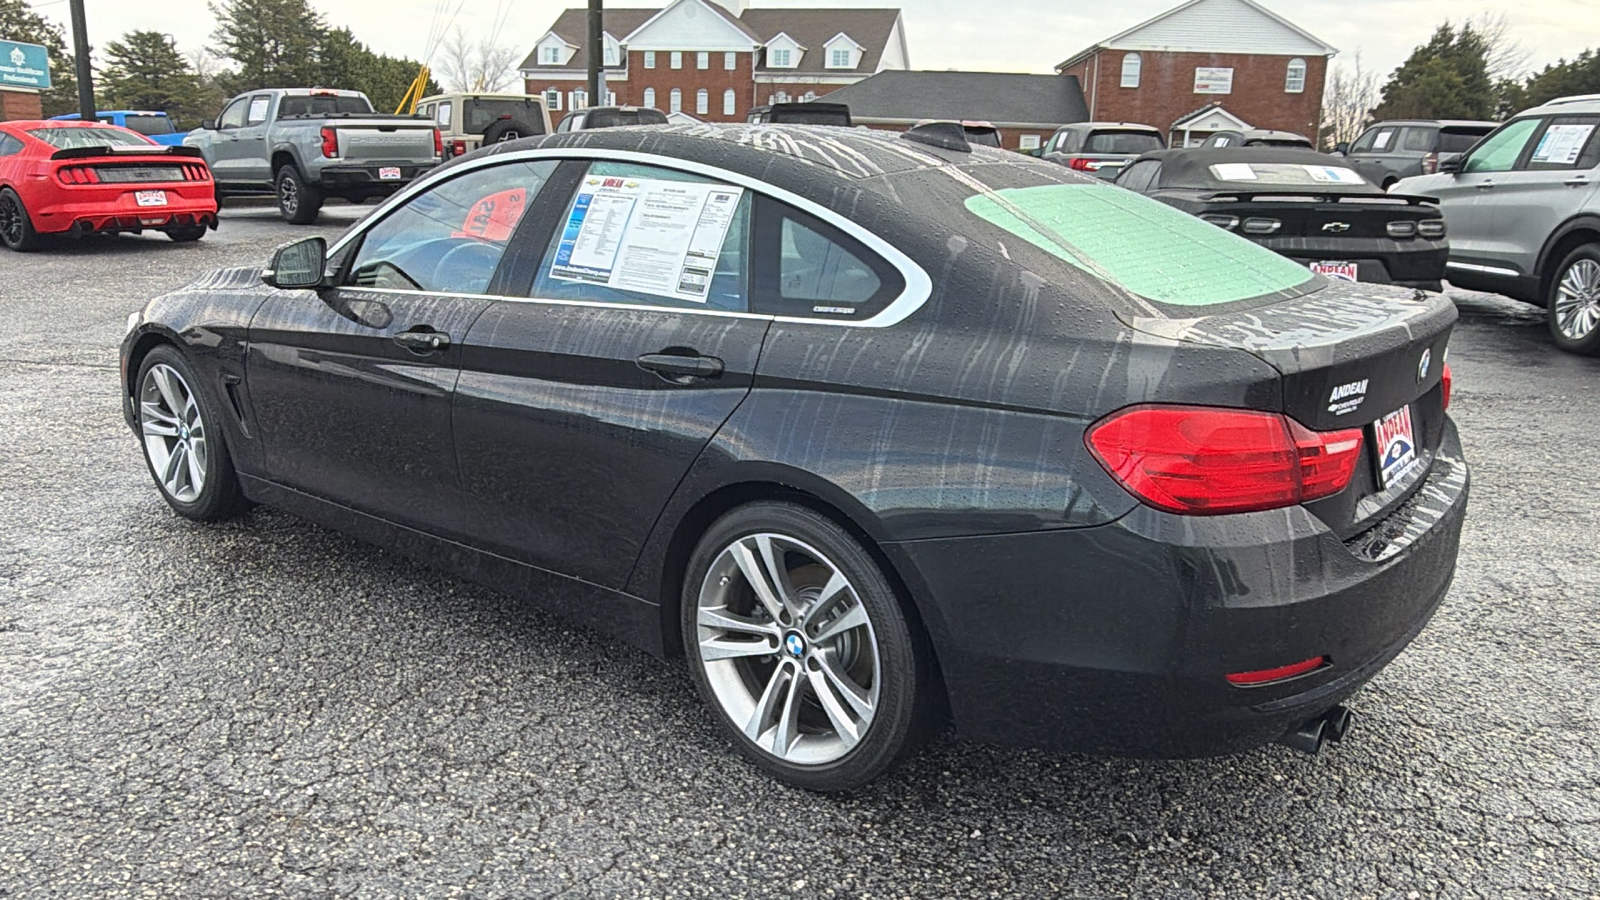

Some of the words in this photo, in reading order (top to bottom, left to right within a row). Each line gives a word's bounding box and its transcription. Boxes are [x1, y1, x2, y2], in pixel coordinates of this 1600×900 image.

[350, 136, 427, 145] CHEVROLET
[1313, 265, 1355, 279] ANDEAN
[1329, 378, 1369, 403] ANDEAN
[1376, 405, 1412, 457] ANDEAN
